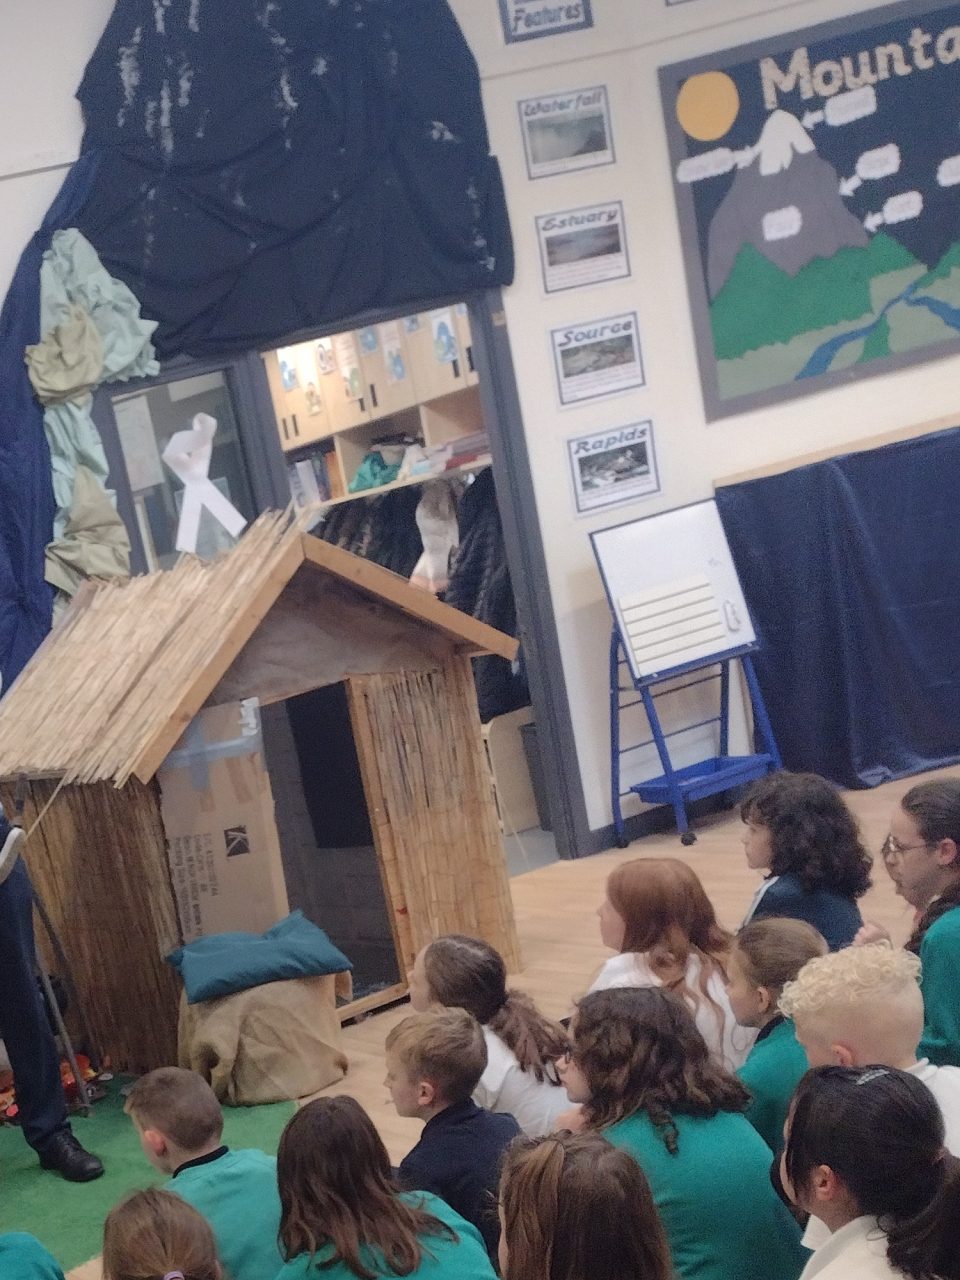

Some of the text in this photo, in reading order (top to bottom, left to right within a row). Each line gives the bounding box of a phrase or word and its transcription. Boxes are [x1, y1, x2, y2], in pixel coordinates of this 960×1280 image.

[523, 91, 604, 117] Waterfall
[541, 208, 618, 232] Estuary
[557, 320, 633, 348] Source
[573, 427, 648, 456] Rapids
